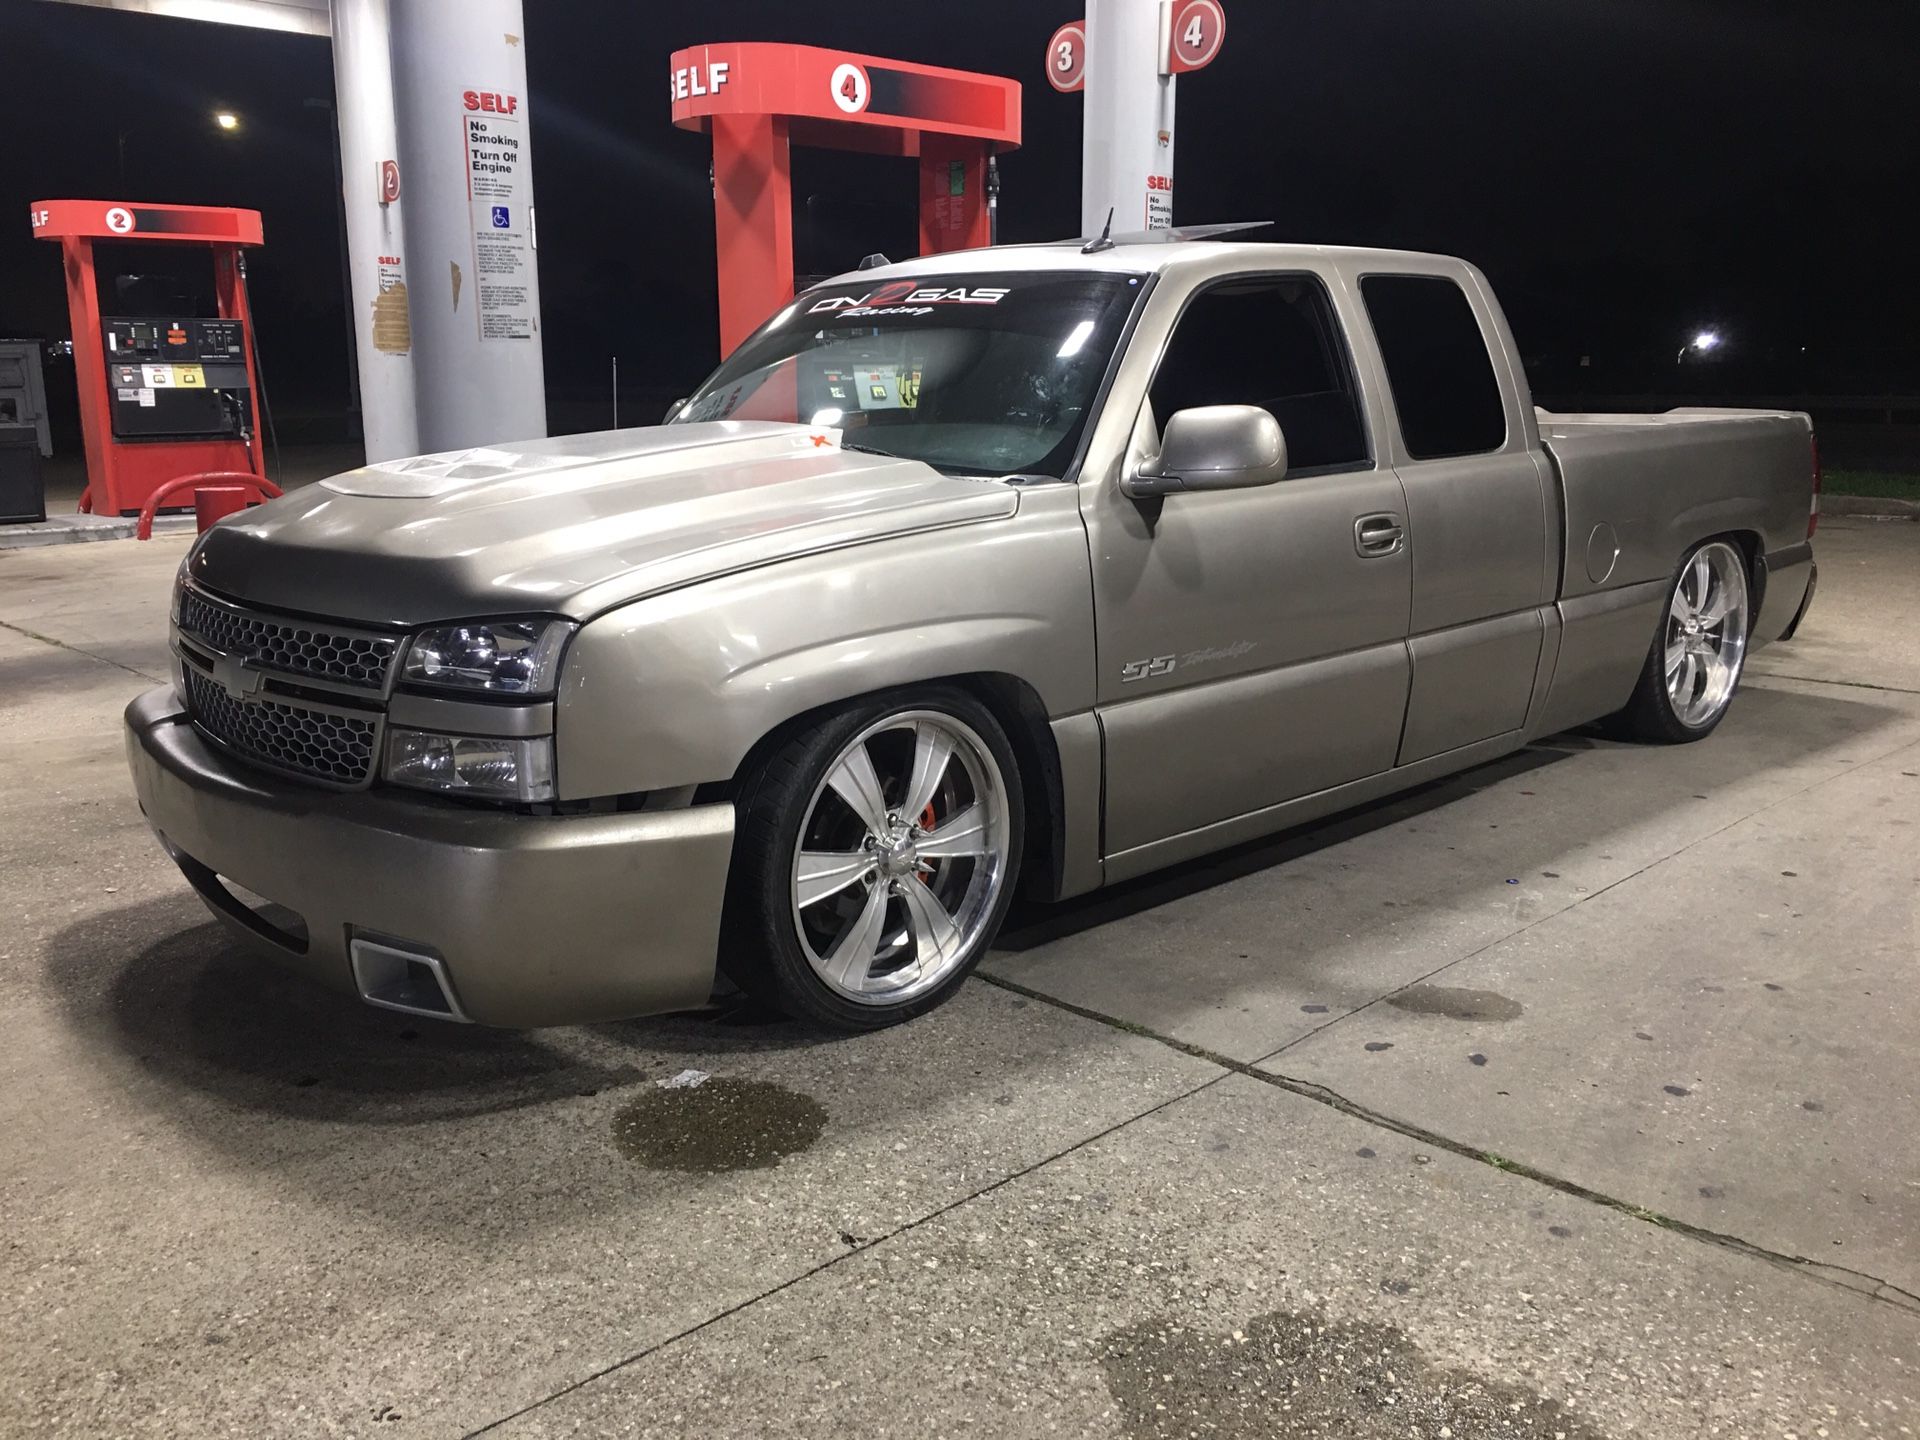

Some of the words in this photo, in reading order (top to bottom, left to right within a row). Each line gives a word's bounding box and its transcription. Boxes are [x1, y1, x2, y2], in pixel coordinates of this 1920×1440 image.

[1183, 15, 1203, 48] 4
[1057, 41, 1073, 72] 3
[840, 74, 858, 103] 4
[463, 90, 517, 115] SELF
[470, 121, 487, 132] No
[470, 133, 518, 149] Smoking
[471, 149, 500, 161] Turn
[503, 151, 517, 163] Off
[472, 160, 512, 174] Engine
[386, 171, 394, 188] 2
[1150, 196, 1160, 204] No
[113, 213, 126, 228] 2
[378, 256, 401, 265] SELF
[835, 306, 934, 318] Racing
